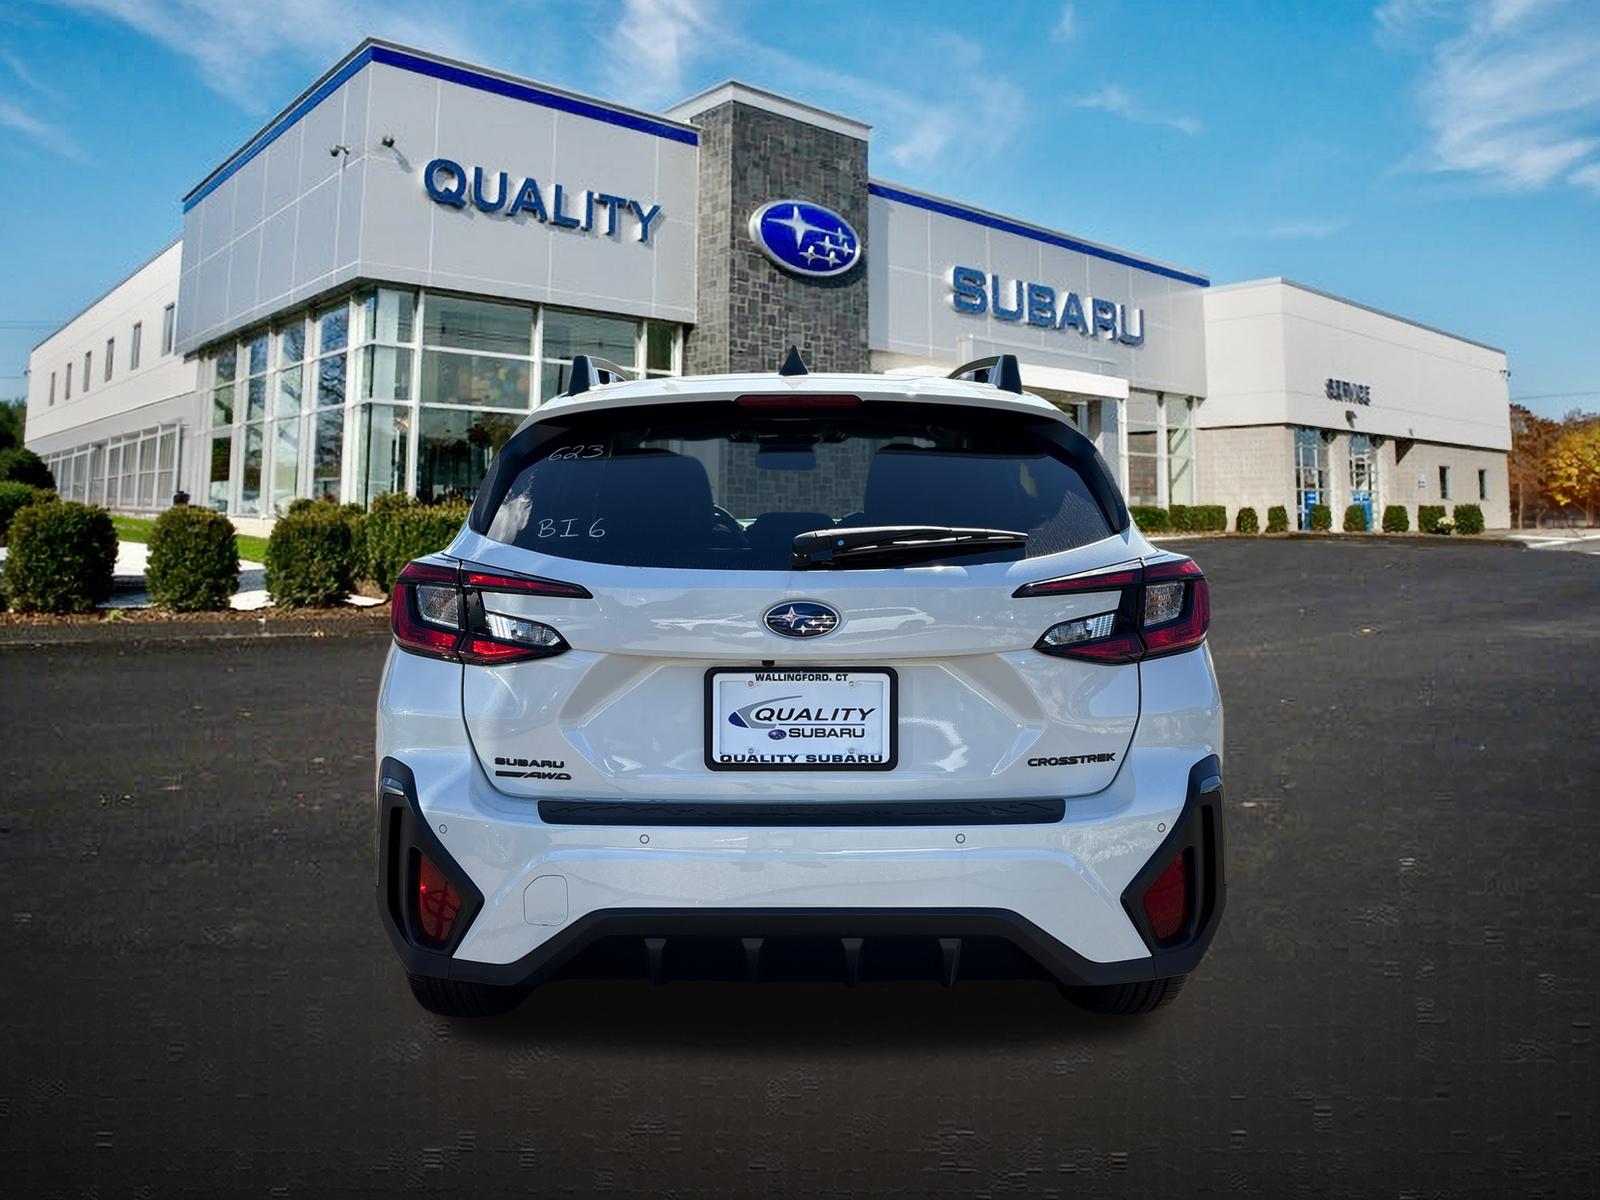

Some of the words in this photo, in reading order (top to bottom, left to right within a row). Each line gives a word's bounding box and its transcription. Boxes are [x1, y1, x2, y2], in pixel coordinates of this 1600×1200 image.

[424, 158, 662, 243] QUALITY
[947, 265, 1145, 346] SUBARU
[549, 444, 604, 461] 623
[835, 673, 848, 682] CT
[754, 707, 876, 722] QUALITY
[788, 727, 865, 739] SUBARU
[494, 757, 564, 769] SUBARU
[719, 754, 798, 764] QUALITY
[805, 754, 883, 764] SUBARU
[1027, 752, 1116, 767] CROSSTREK
[523, 771, 572, 780] AWD
